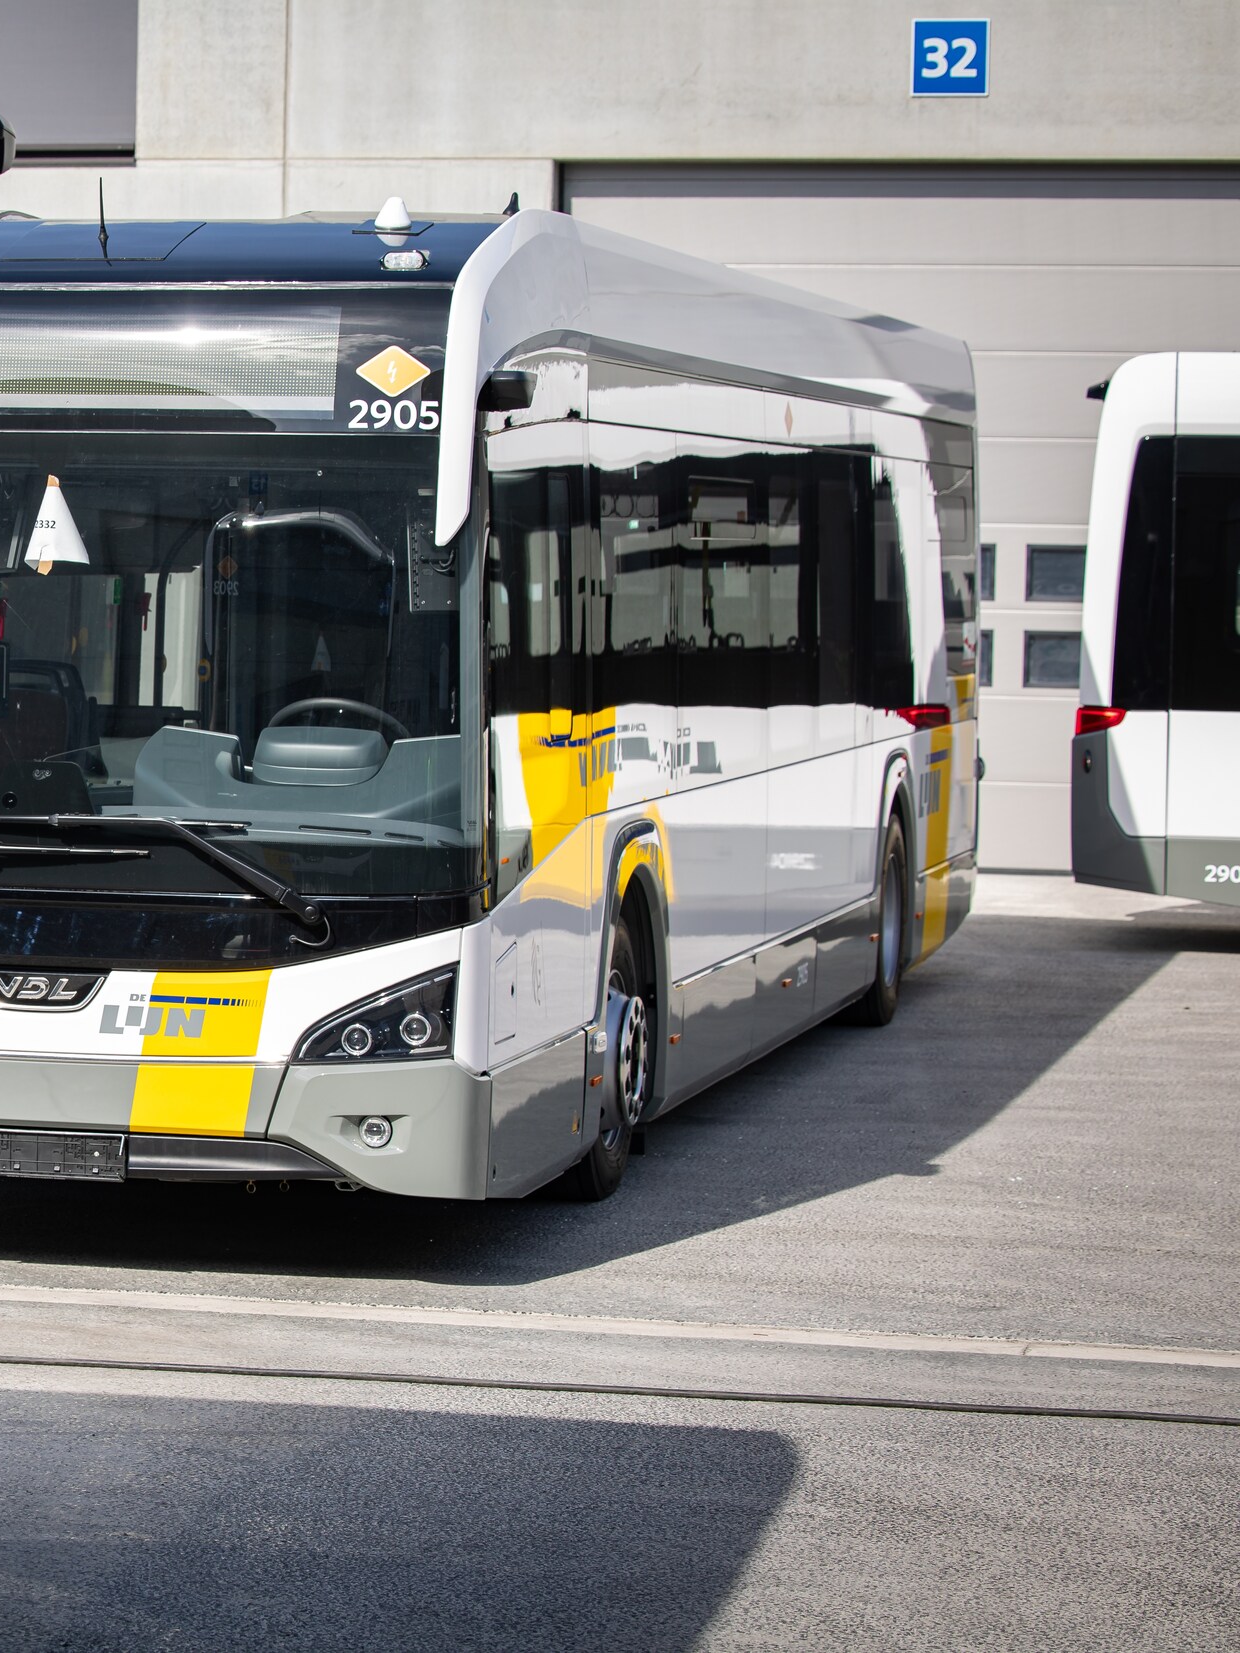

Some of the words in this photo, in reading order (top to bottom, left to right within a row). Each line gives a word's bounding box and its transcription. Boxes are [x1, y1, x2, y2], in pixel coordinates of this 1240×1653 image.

[921, 37, 978, 79] 32
[347, 399, 440, 430] 2905
[130, 993, 147, 1003] DE
[99, 1004, 206, 1039] LIJN
